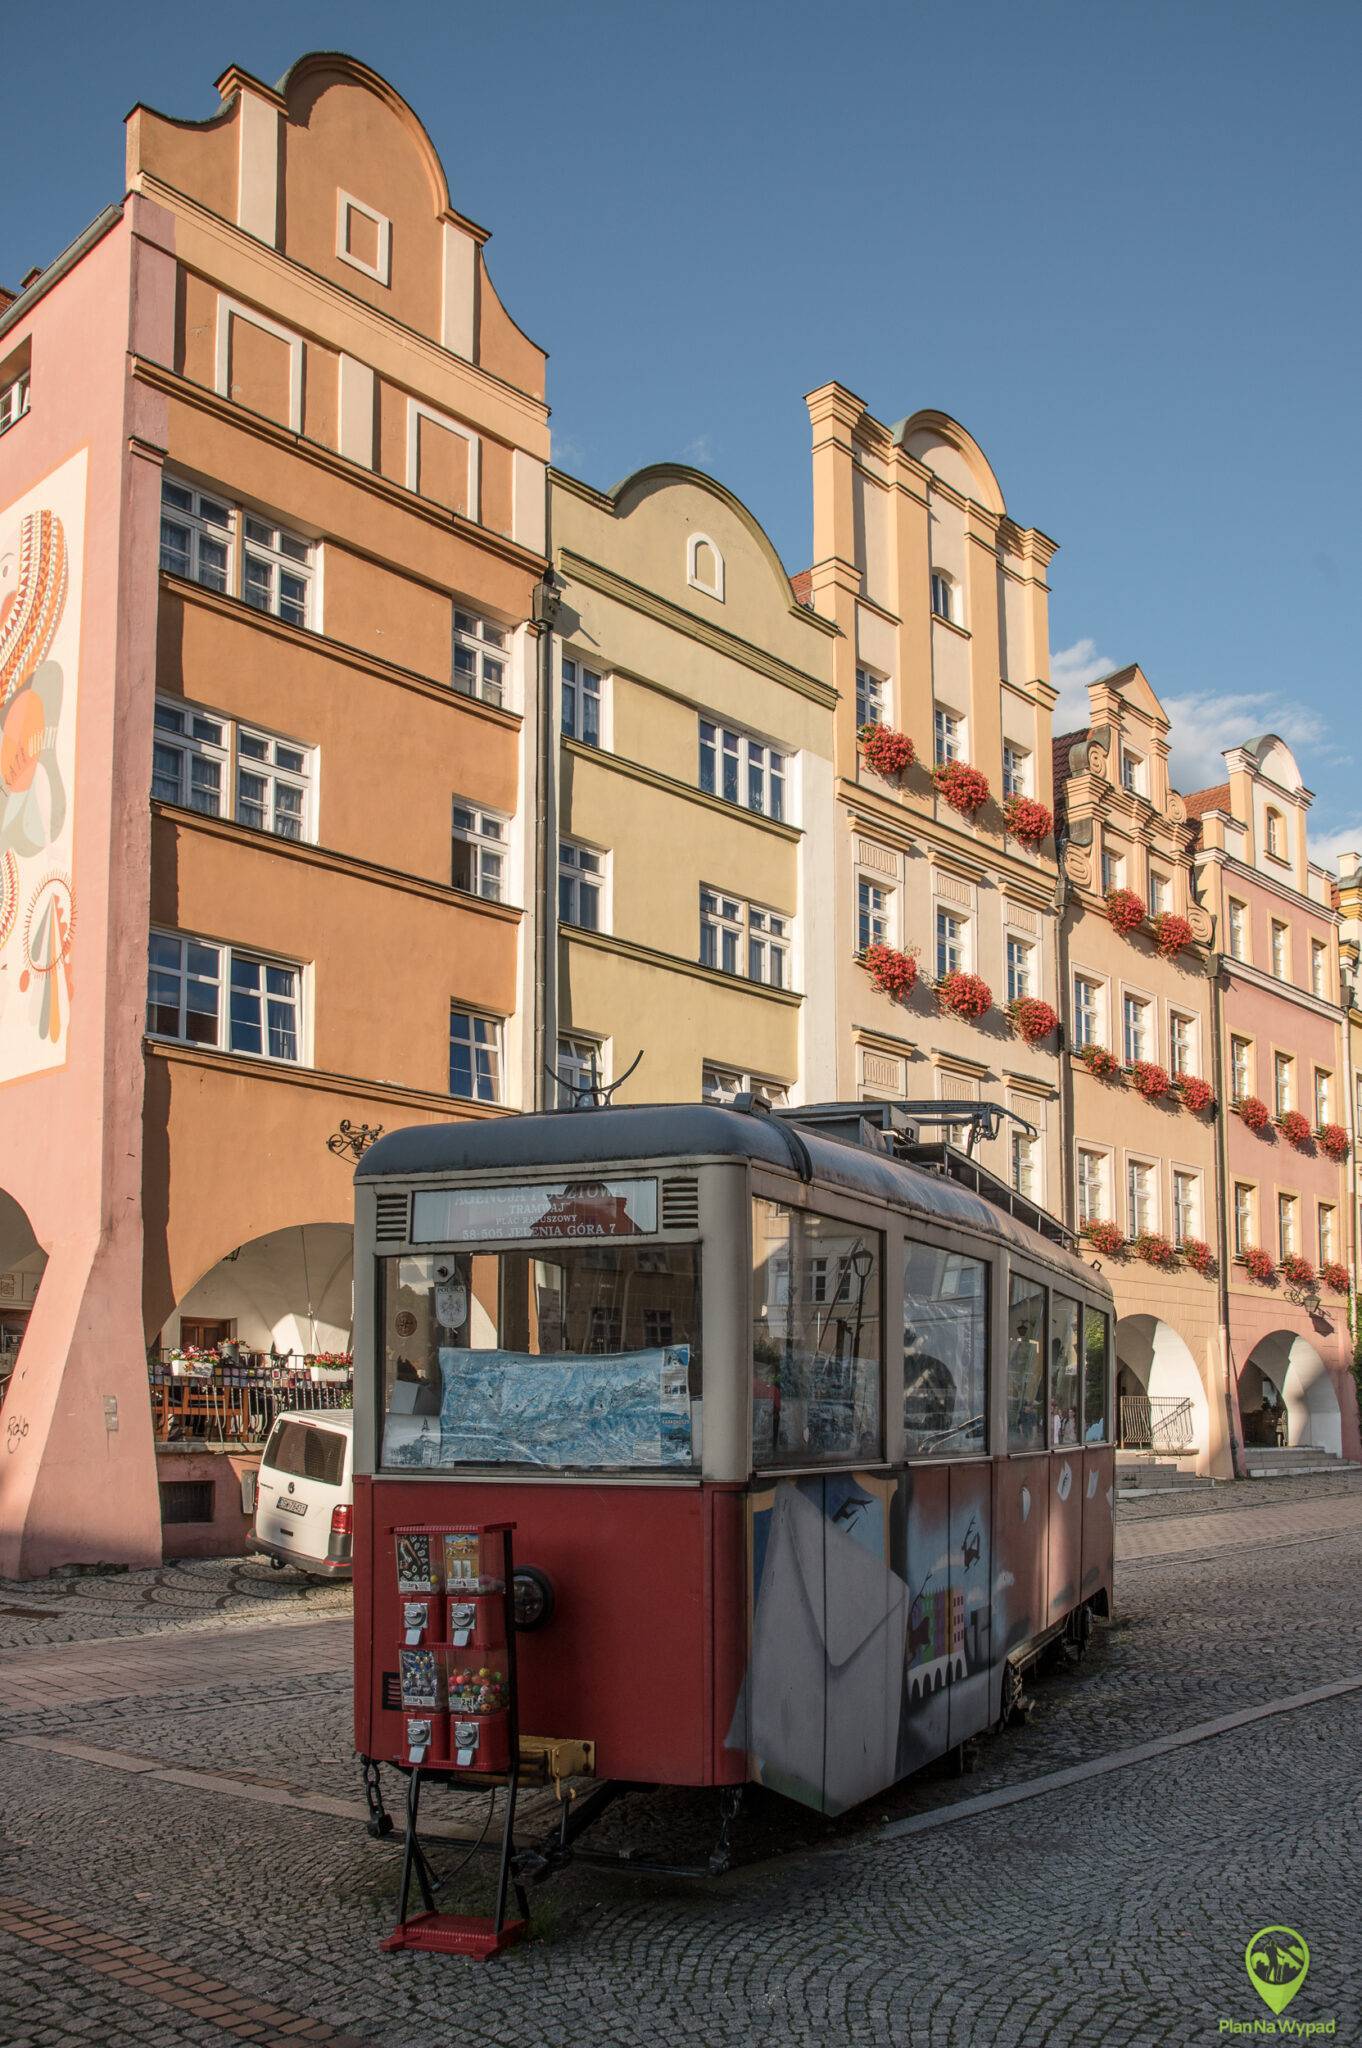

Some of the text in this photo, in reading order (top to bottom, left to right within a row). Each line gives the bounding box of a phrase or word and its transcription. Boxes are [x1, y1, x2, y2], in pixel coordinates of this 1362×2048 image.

[508, 1225, 563, 1238] JELENIA
[567, 1222, 604, 1236] GÓRA
[609, 1223, 616, 1234] 7
